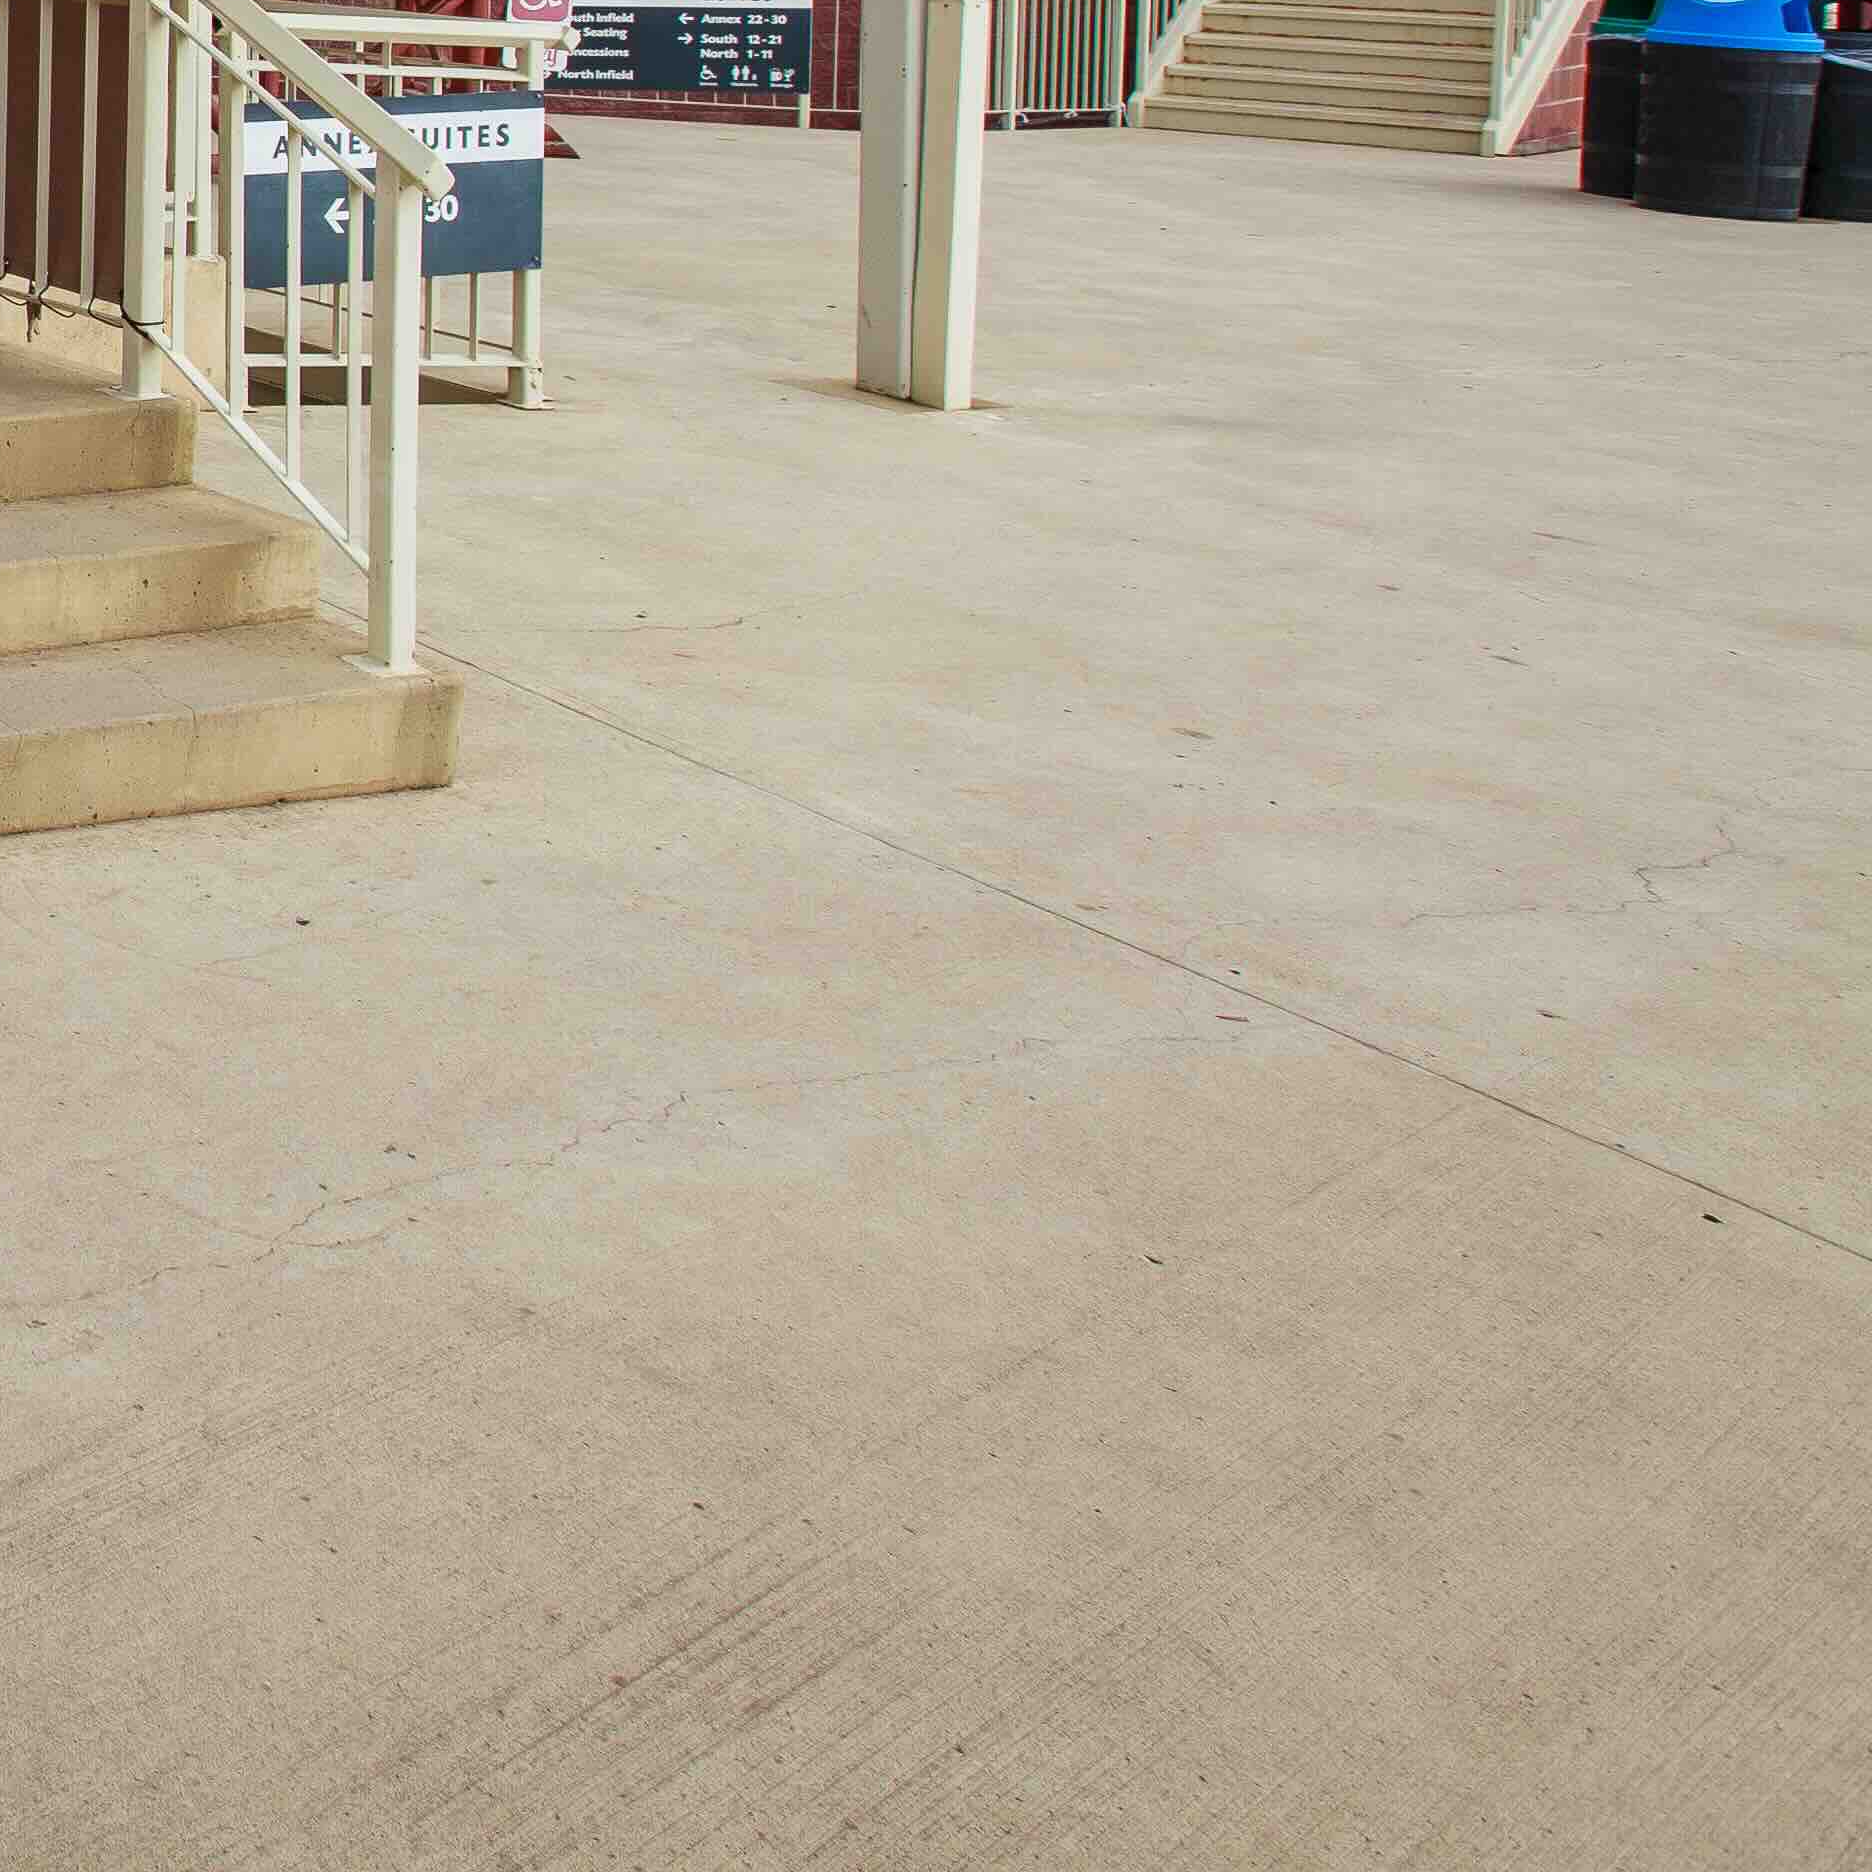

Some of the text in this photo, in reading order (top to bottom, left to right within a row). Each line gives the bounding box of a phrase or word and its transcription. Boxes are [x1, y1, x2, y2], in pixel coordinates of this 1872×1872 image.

[596, 12, 634, 23] Infield
[700, 13, 742, 24] Annex
[583, 28, 628, 41] Seating
[700, 33, 739, 44] South
[569, 47, 630, 58] ncessions
[699, 48, 739, 59] North
[558, 69, 634, 81] North Infield
[273, 123, 511, 160] ANNE UITES
